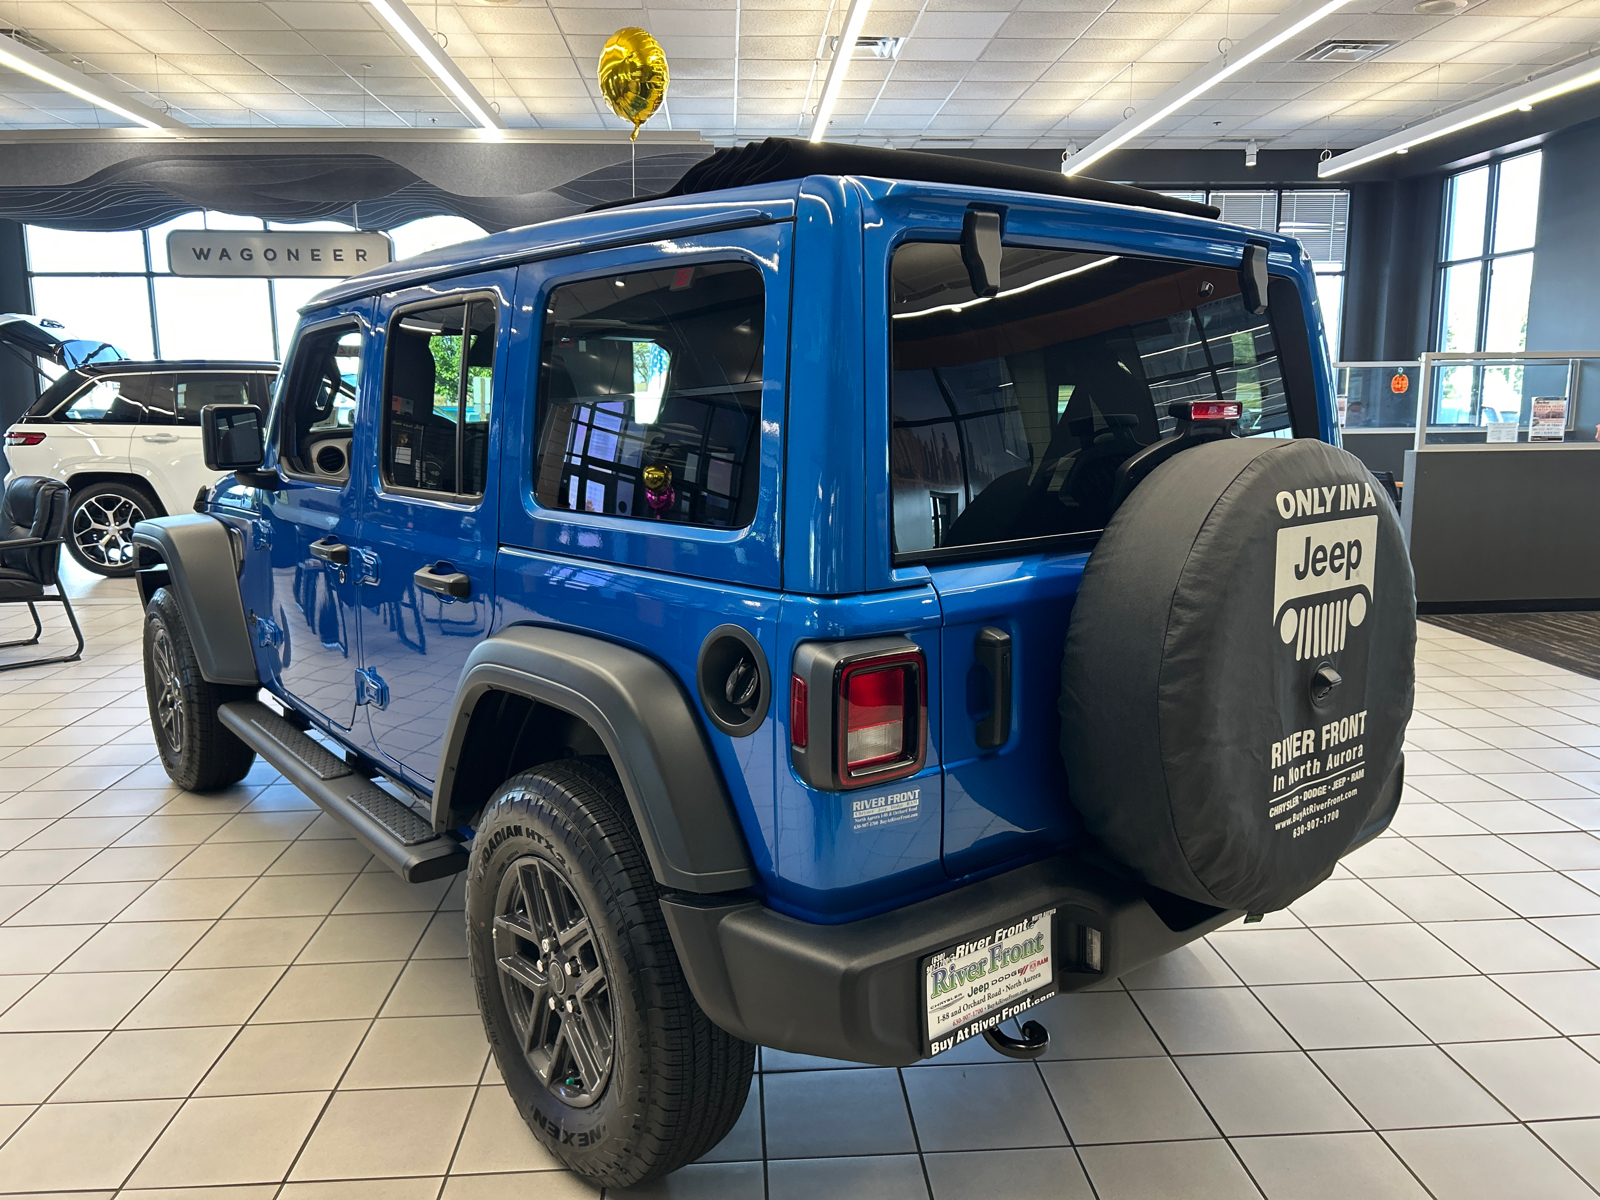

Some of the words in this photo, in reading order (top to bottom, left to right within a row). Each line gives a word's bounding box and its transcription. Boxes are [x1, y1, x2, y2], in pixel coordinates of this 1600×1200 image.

[192, 247, 368, 262] WAGONEER
[1275, 485, 1337, 520] ONLY
[1339, 483, 1360, 512] IN
[1362, 482, 1377, 509] A
[1294, 535, 1363, 581] Jeep
[1271, 729, 1316, 770] RIVER
[1321, 709, 1368, 751] FRONT
[1272, 774, 1285, 793] In
[1288, 758, 1321, 786] North
[1326, 744, 1364, 771] Aurora
[853, 797, 886, 811] RIVER
[887, 789, 920, 805] FRONT
[1269, 795, 1300, 818] CHRYSLER
[1303, 784, 1327, 802] DODGE
[1331, 776, 1347, 791] JEEP
[1350, 768, 1365, 783] RAM
[1274, 788, 1358, 831] www.BuyAtRiverFront.com
[1292, 809, 1340, 839] 630-907-1700
[955, 935, 992, 959] River
[994, 918, 1028, 943] Front
[930, 993, 963, 1010] CHRYSLER
[967, 982, 990, 998] Jeep
[991, 967, 1023, 986] DODGE
[1037, 956, 1049, 967] RAM
[931, 957, 988, 999] River
[988, 931, 1045, 974] Front
[951, 1006, 962, 1018] and
[962, 994, 986, 1011] Orchard
[986, 988, 1002, 1000] Road
[1005, 979, 1022, 992] North
[1022, 972, 1042, 985] Aurora
[931, 1036, 953, 1056] Buy
[956, 1029, 970, 1044] At
[970, 1013, 1001, 1036] River
[1001, 991, 1055, 1021] Front.com
[533, 1107, 602, 1147] NEXEN
